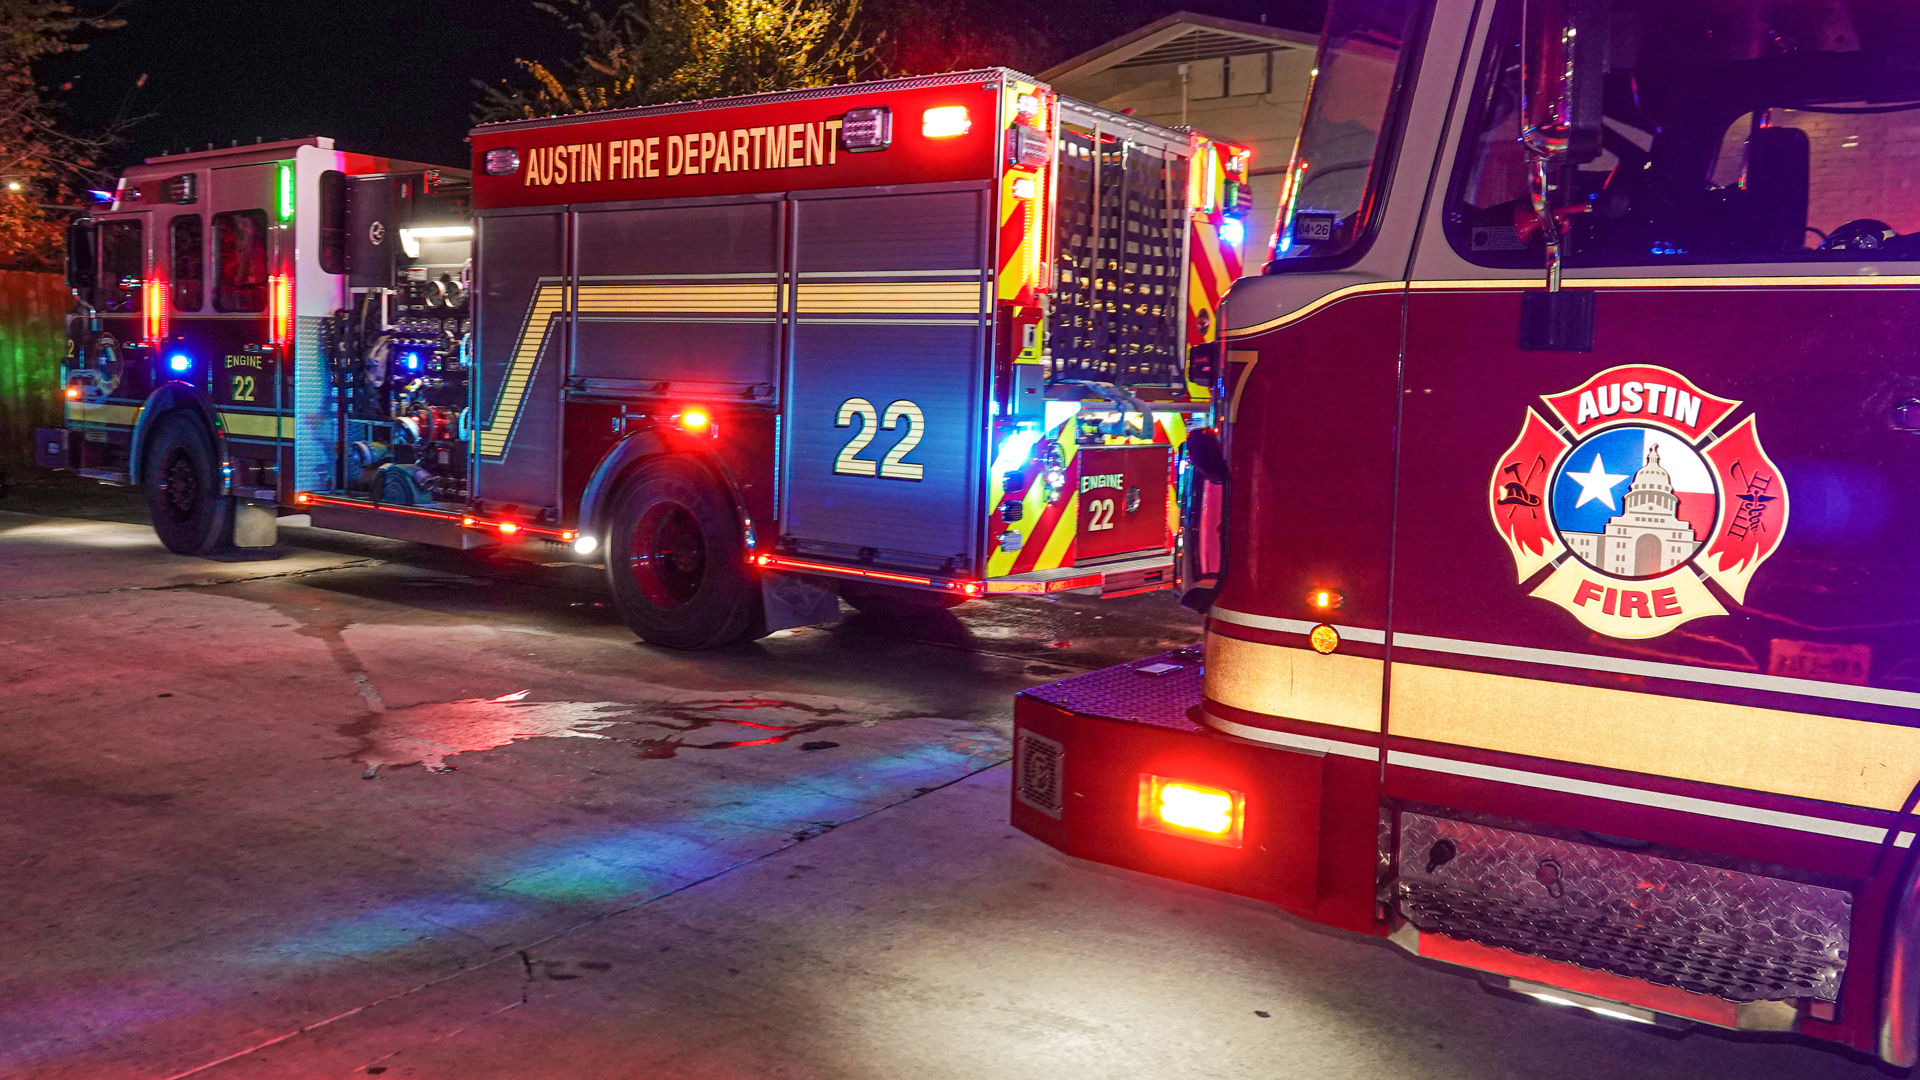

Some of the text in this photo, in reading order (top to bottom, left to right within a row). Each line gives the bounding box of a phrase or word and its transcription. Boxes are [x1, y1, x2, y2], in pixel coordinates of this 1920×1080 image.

[524, 119, 843, 187] AUSTIN FIRE DEPARTMENT
[225, 355, 263, 370] ENGINE
[233, 375, 255, 402] 22
[1227, 350, 1259, 424] 7
[1577, 381, 1702, 428] AUSTIN
[833, 397, 925, 482] 22
[1081, 474, 1124, 494] ENGINE
[1088, 499, 1115, 533] 22
[1572, 578, 1683, 619] FIRE
